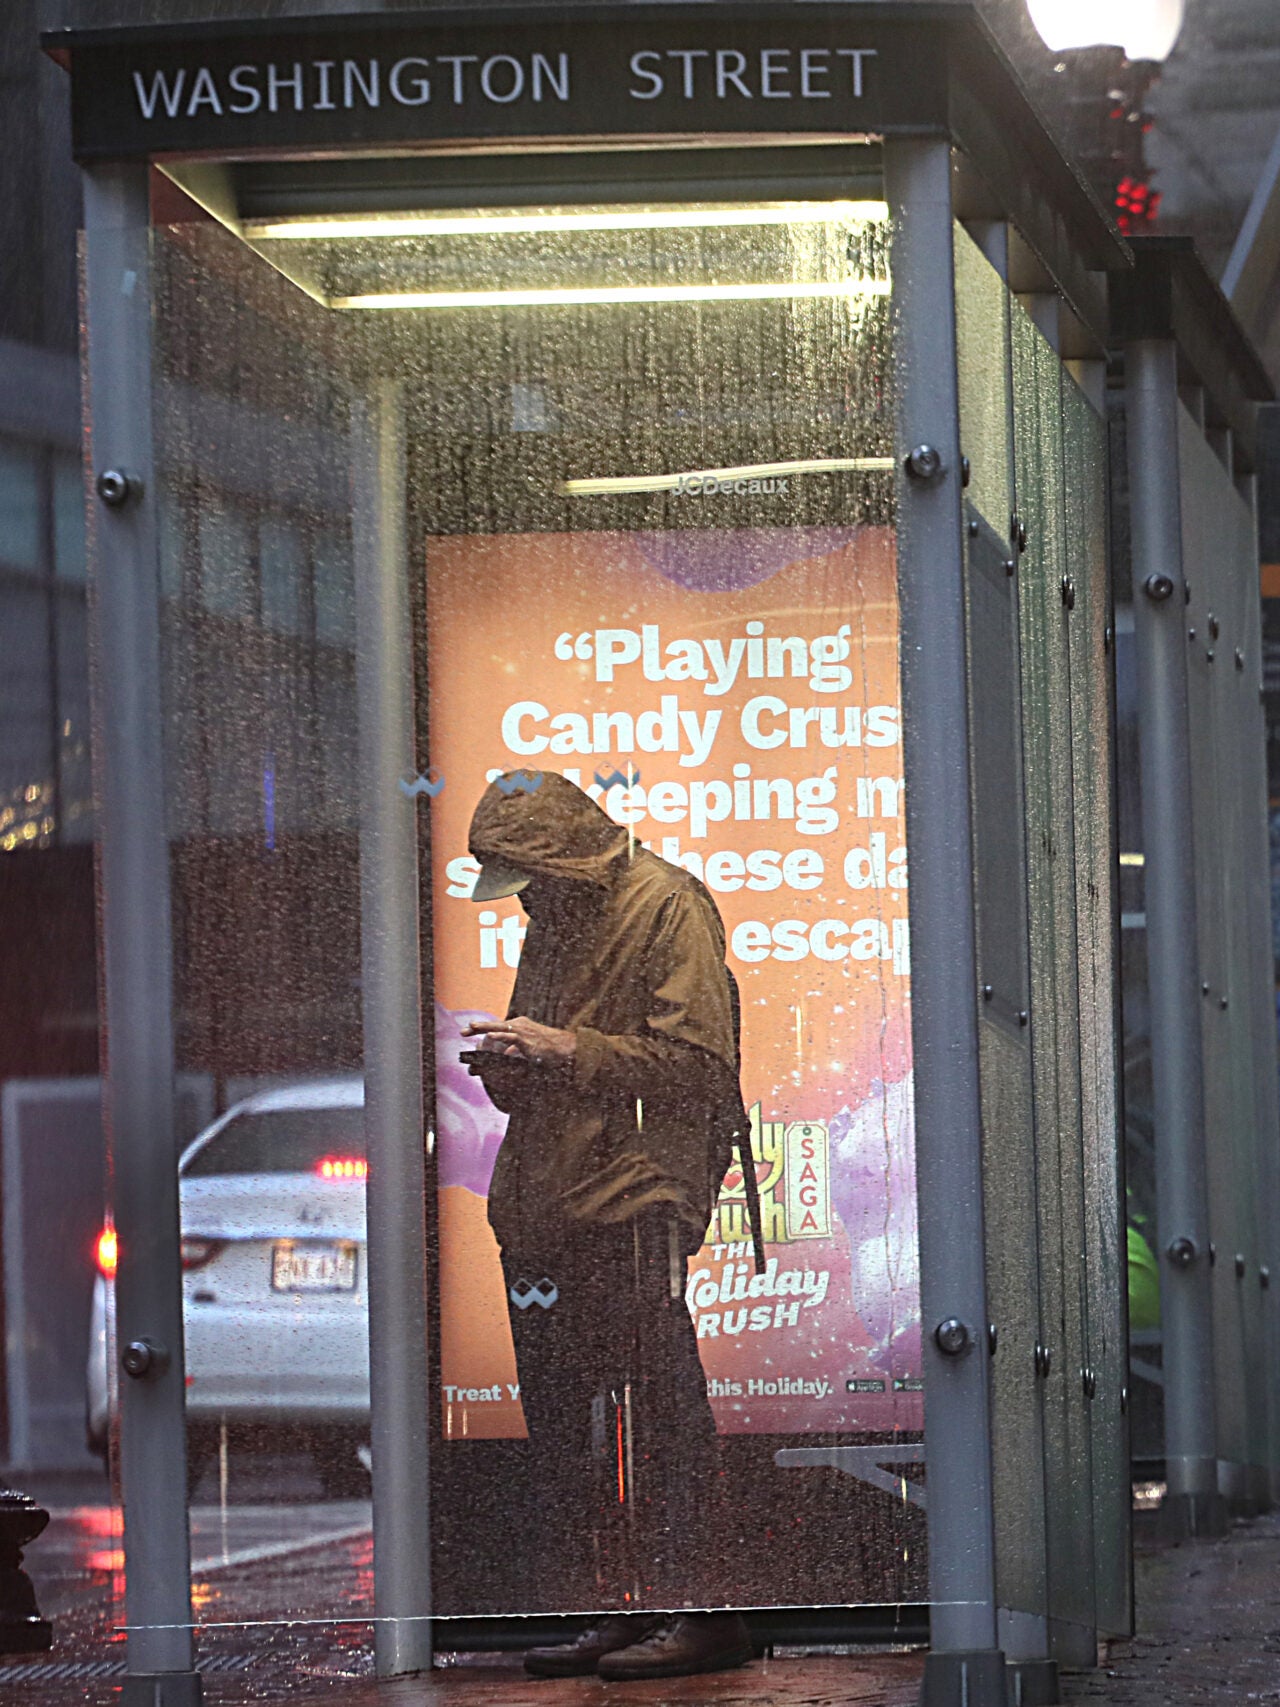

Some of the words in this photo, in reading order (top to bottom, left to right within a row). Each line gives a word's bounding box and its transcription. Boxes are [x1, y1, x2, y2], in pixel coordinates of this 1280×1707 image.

[133, 52, 571, 120] WASHINGTON
[629, 48, 878, 100] STREET
[671, 476, 788, 496] JCDecaux
[501, 695, 722, 767] Candy
[643, 836, 824, 893] hese
[799, 1138, 818, 1231] SAGA
[693, 1302, 800, 1339] RUSH
[443, 1384, 502, 1402] Treat
[748, 1377, 833, 1399] Holiday.
